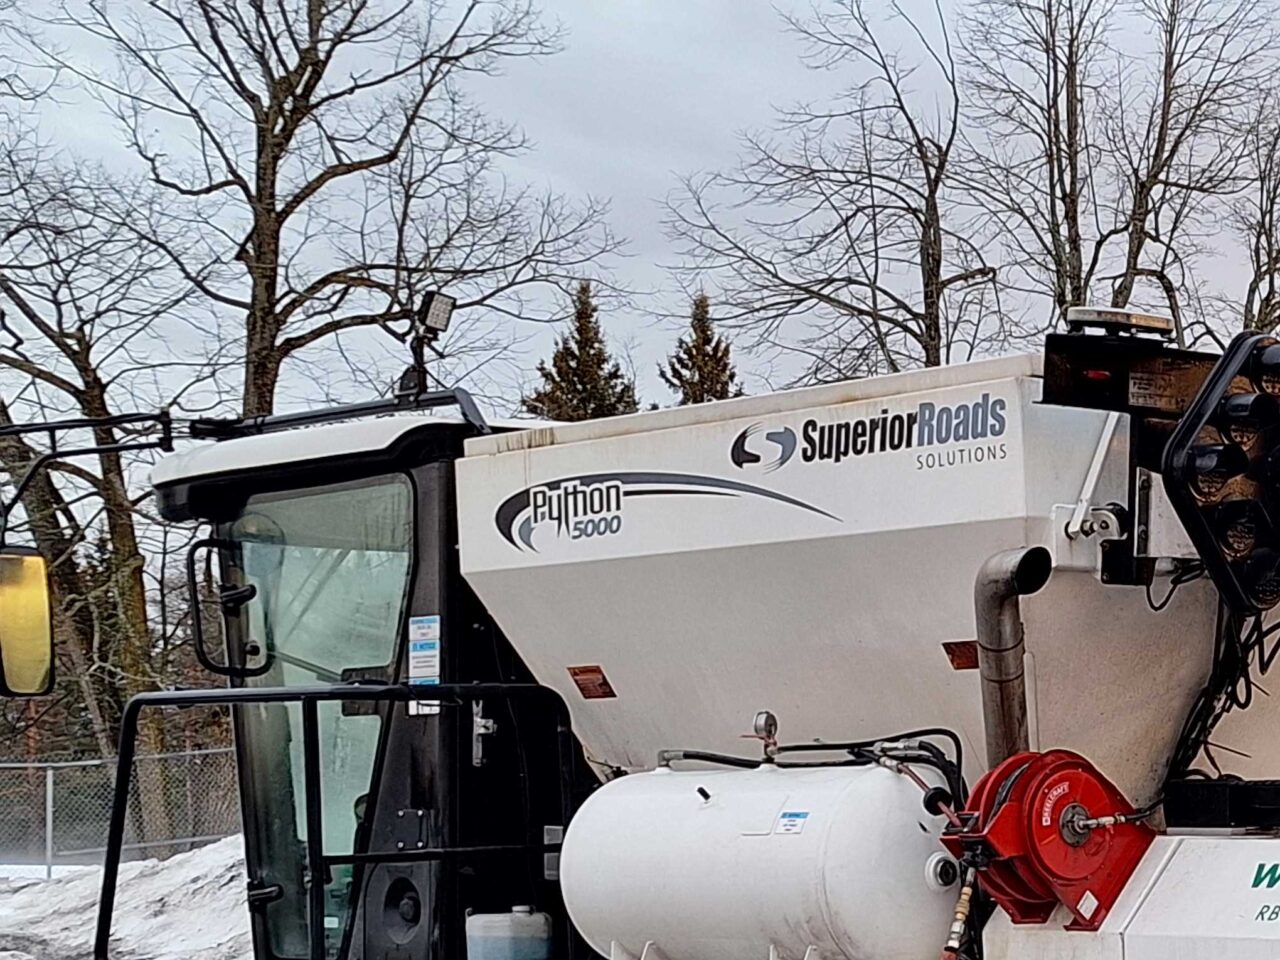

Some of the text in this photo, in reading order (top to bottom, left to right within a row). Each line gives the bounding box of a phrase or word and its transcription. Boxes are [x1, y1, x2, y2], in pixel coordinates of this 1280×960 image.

[916, 443, 1008, 470] SOLUTIONS
[532, 484, 621, 537] Python
[571, 515, 622, 540] 5000
